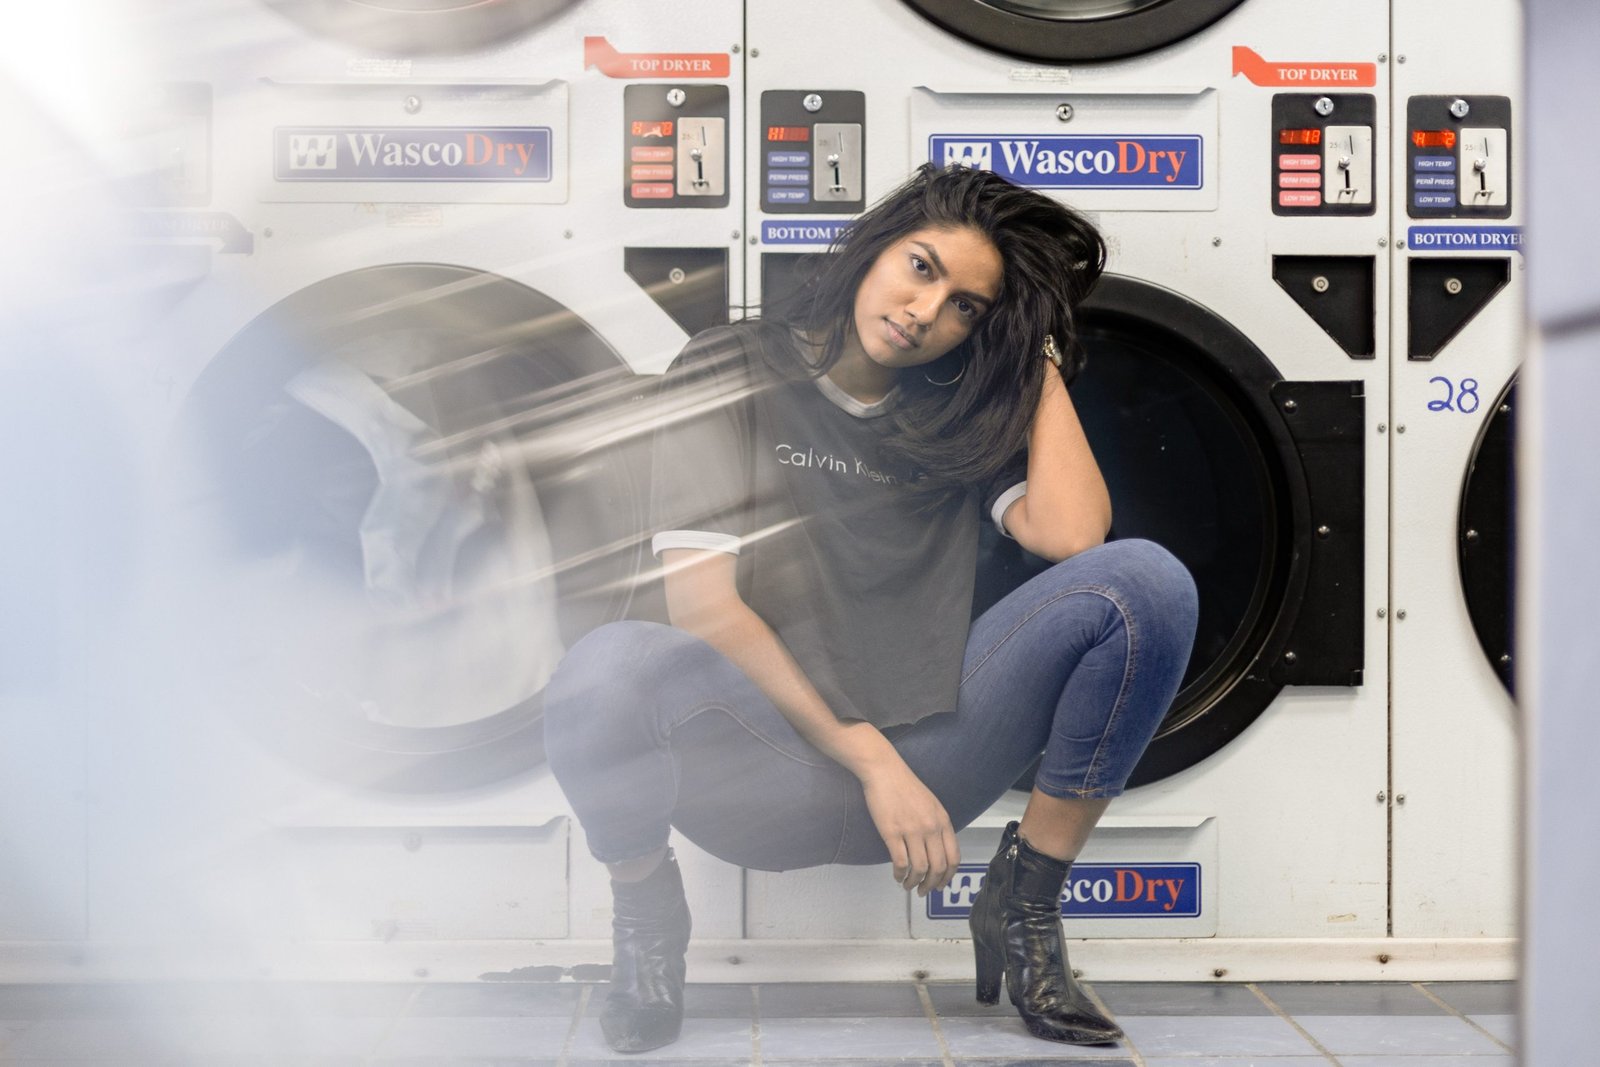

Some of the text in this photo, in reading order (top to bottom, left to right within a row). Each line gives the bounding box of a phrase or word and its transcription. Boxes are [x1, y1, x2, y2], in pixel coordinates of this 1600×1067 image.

[631, 59, 712, 71] TOP DRYER
[1277, 68, 1358, 80] TOP DRYER
[345, 133, 536, 176] WascoDry
[999, 140, 1187, 183] WascoDry
[767, 226, 831, 239] BOTTOM
[1414, 233, 1477, 245] BOTTOM
[1427, 376, 1480, 414] 28
[775, 444, 898, 485] Calvin Klein
[1060, 869, 1185, 911] scoDry
